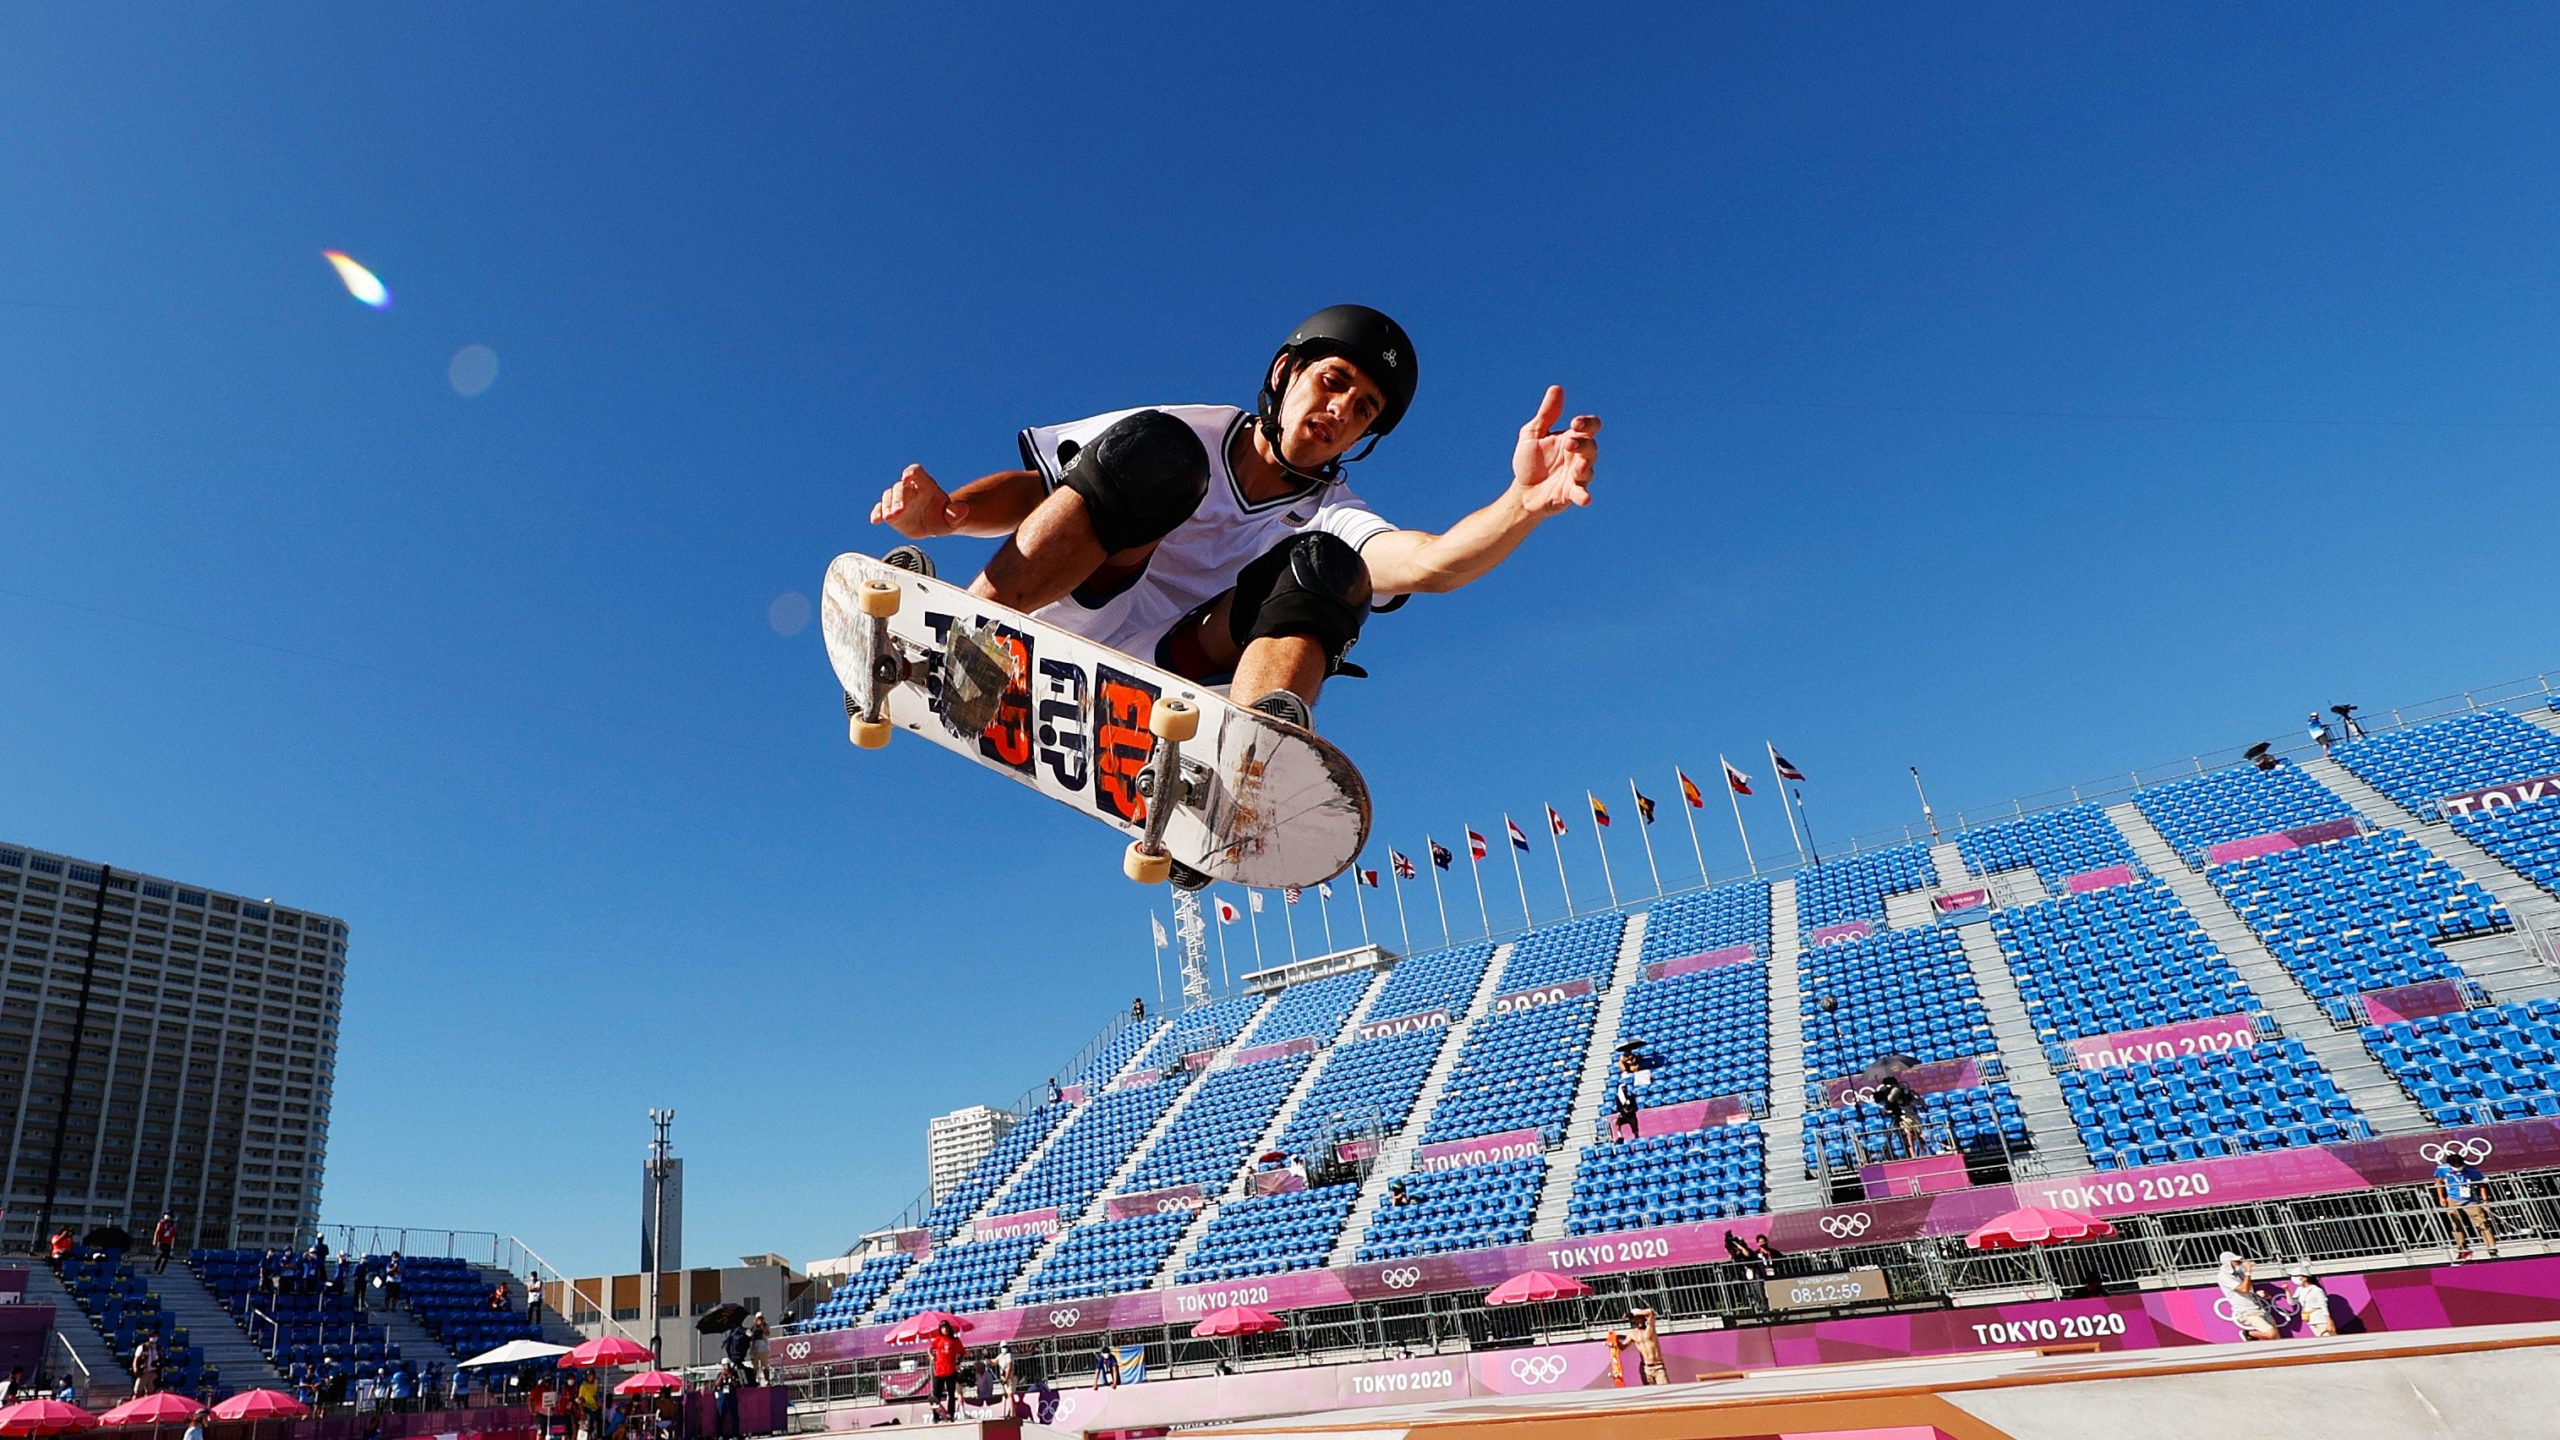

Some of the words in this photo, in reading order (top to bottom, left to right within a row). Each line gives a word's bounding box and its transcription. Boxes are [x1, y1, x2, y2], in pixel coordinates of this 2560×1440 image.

[2079, 1041, 2176, 1069] TOKYO
[2179, 1029, 2251, 1056] 2020
[1424, 1150, 1487, 1173] TOKYO
[1490, 1142, 1538, 1163] 2020
[2043, 1182, 2136, 1209] TOKYO
[2138, 1173, 2210, 1201] 2020
[976, 1224, 1020, 1243] TOKYO
[1022, 1219, 1057, 1236] 2020
[1548, 1244, 1615, 1270] TOKYO
[1617, 1238, 1669, 1262] 2020
[1177, 1291, 1227, 1313] TOKYO
[1229, 1286, 1268, 1307] 2020
[1791, 1283, 1861, 1304] 08:12:59
[1972, 1318, 2058, 1345] TOKYO
[2059, 1313, 2127, 1339] 2020
[1352, 1373, 1408, 1394] TOKYO
[1410, 1369, 1453, 1390] 2020
